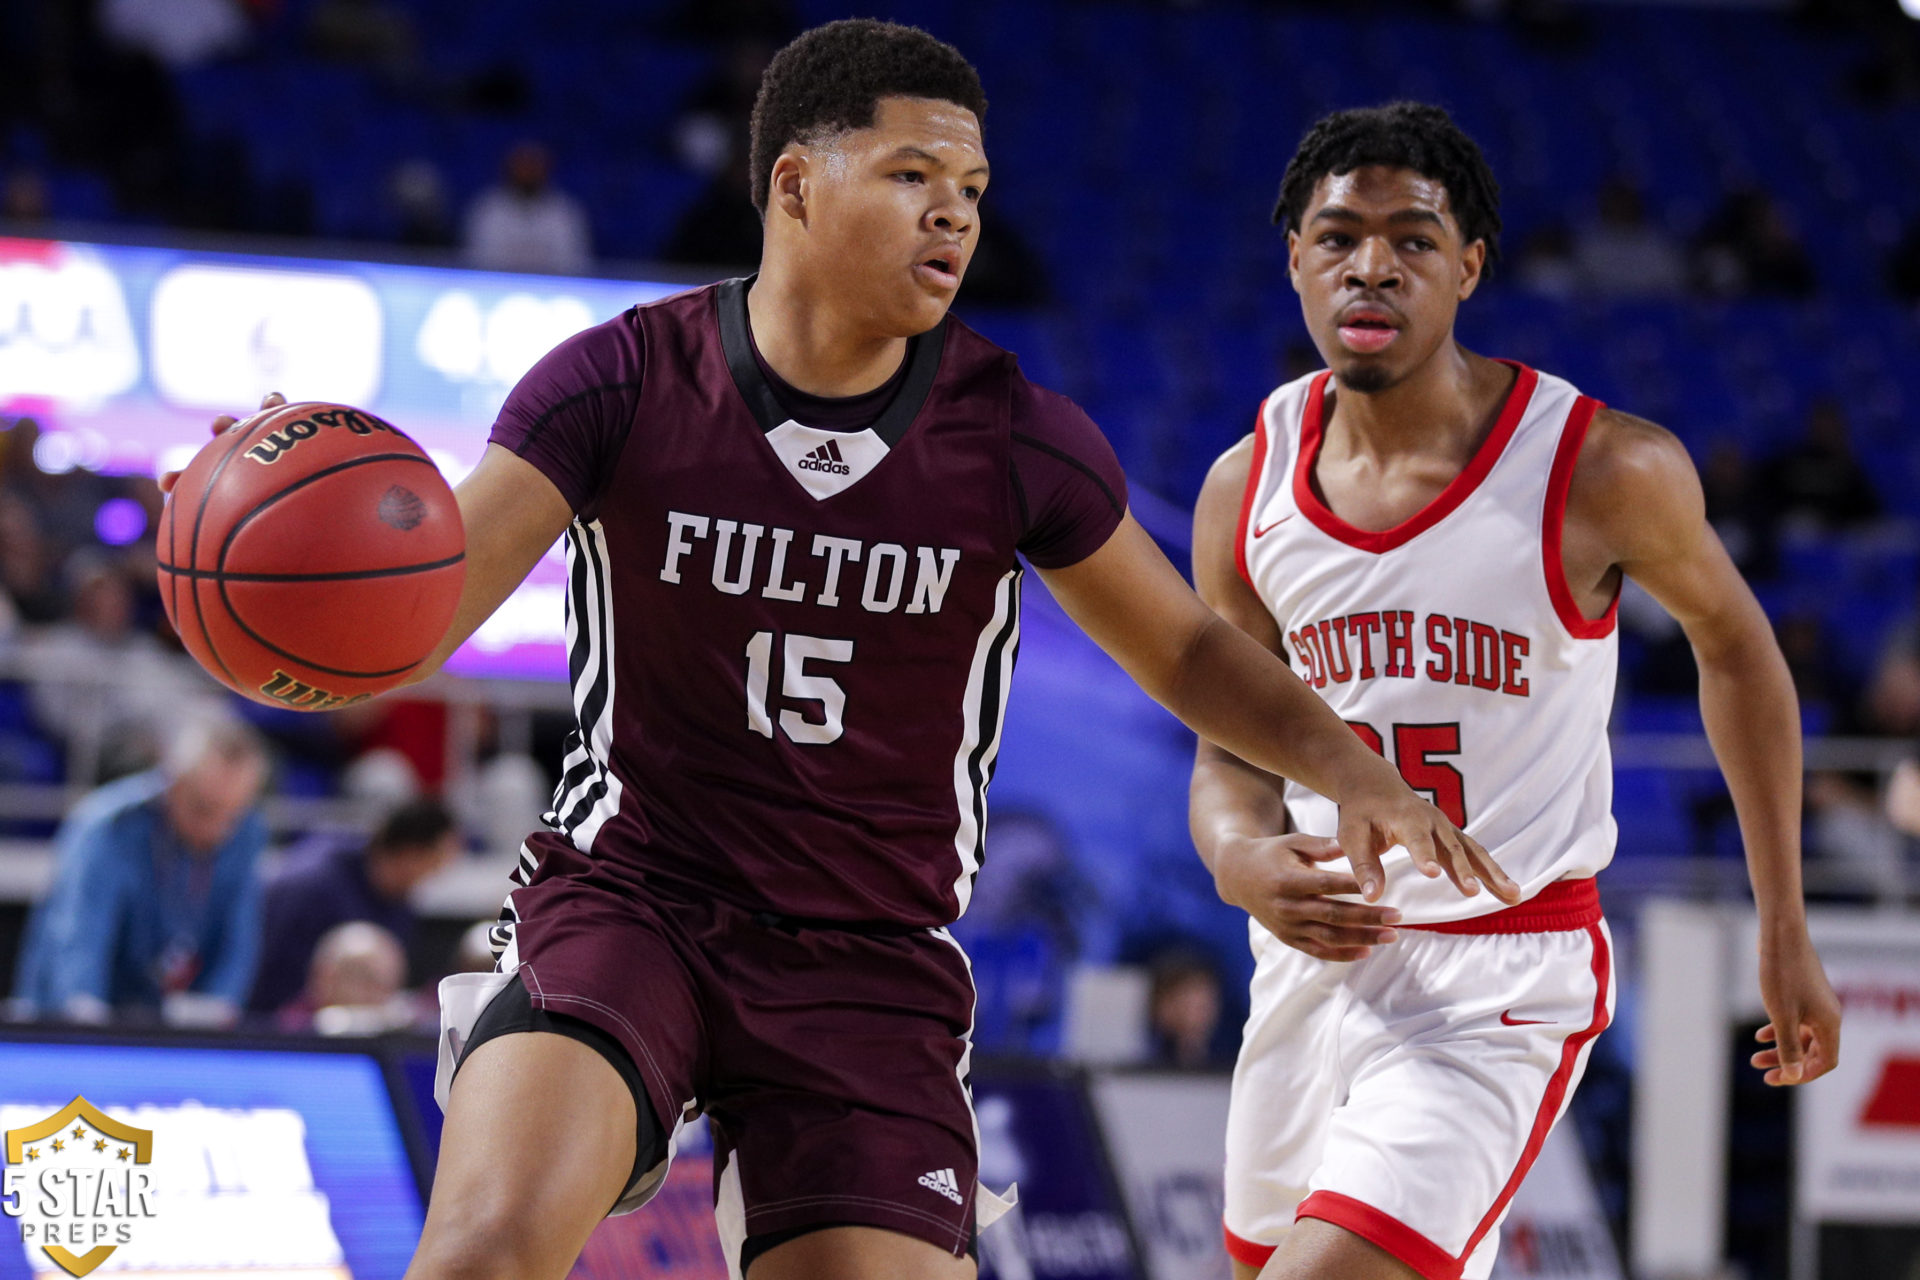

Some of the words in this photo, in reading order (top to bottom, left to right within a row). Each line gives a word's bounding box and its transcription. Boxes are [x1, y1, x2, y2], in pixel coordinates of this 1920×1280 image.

[243, 409, 406, 465] ilson
[798, 458, 850, 475] adidas
[660, 510, 960, 614] FULTON
[745, 631, 854, 745] 15
[1289, 610, 1415, 689] SOUTH
[1426, 613, 1530, 697] SIDE
[917, 1175, 963, 1205] adidas
